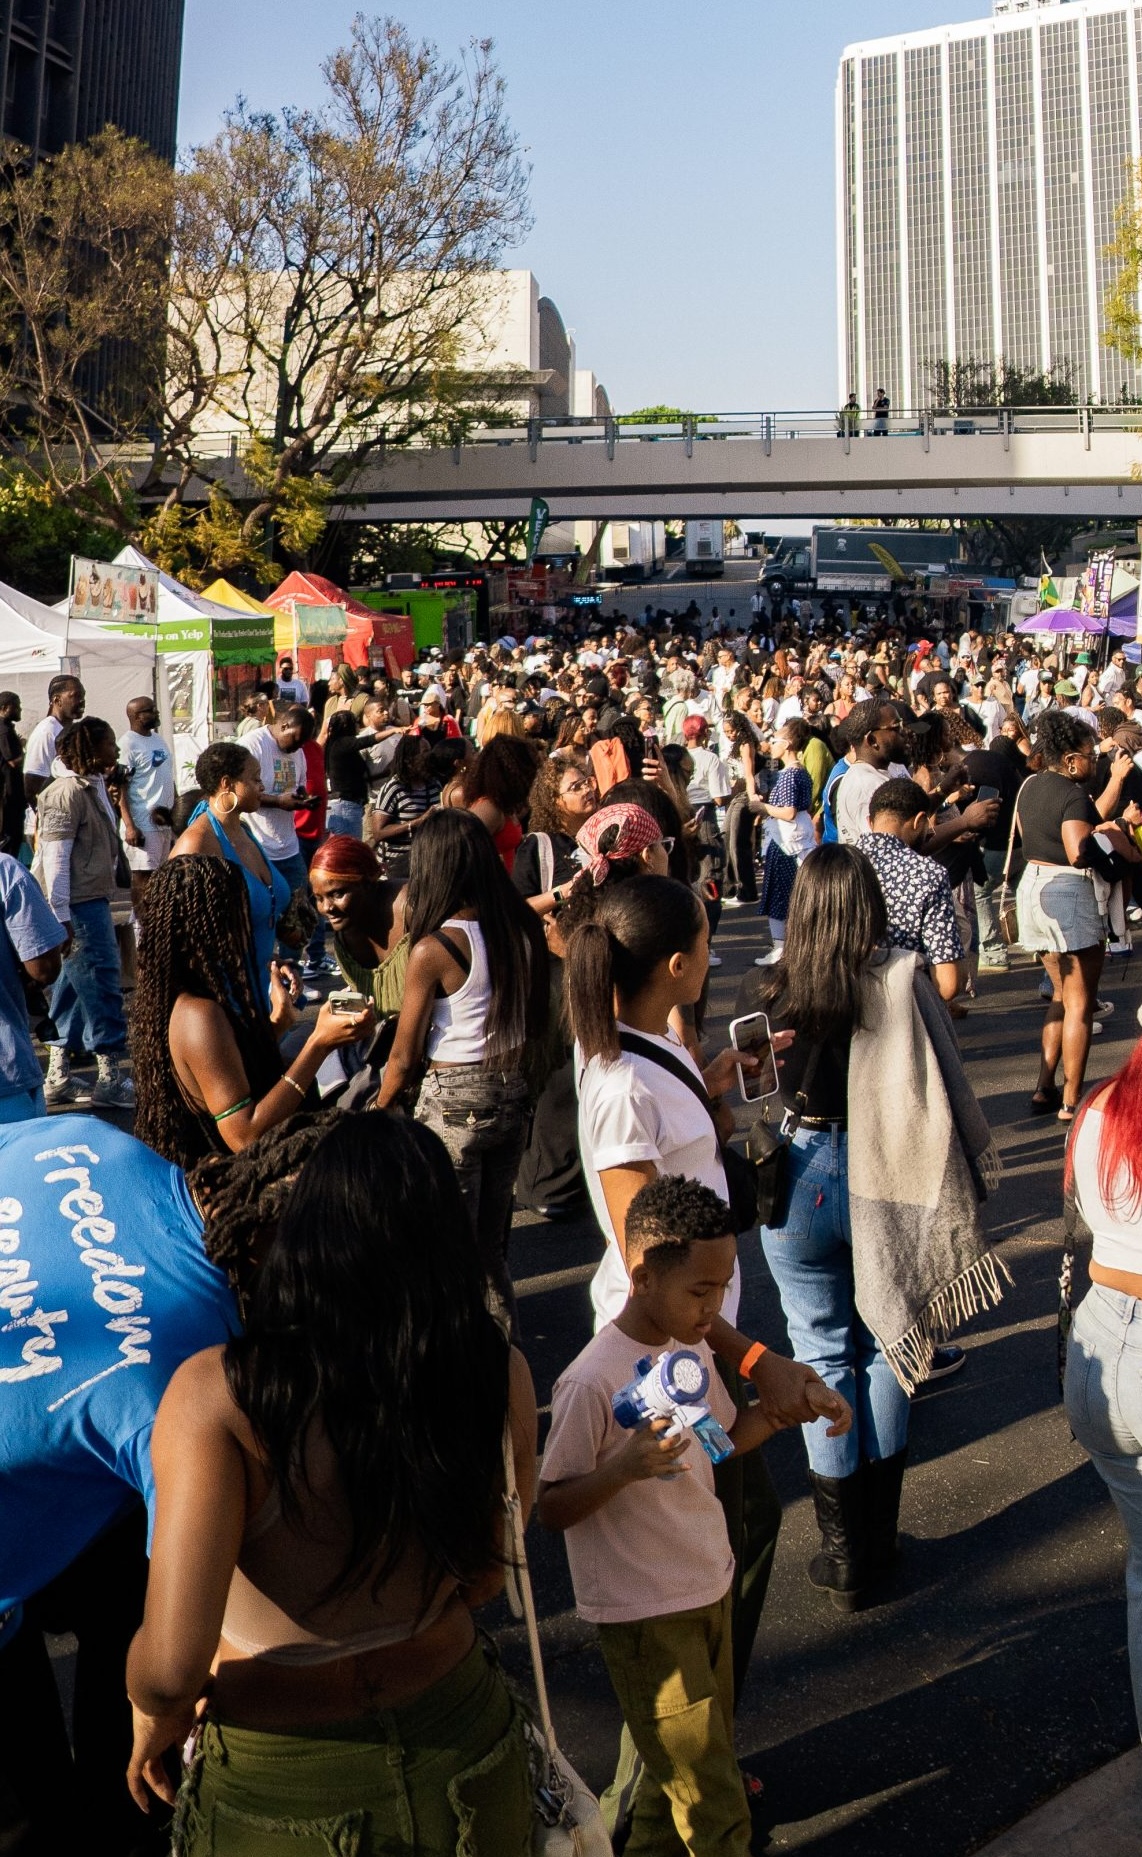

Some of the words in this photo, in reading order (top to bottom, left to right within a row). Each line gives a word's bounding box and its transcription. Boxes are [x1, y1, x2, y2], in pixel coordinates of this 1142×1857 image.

[165, 632, 179, 641] on
[181, 629, 204, 642] Yelp
[34, 1144, 152, 1412] Freedom
